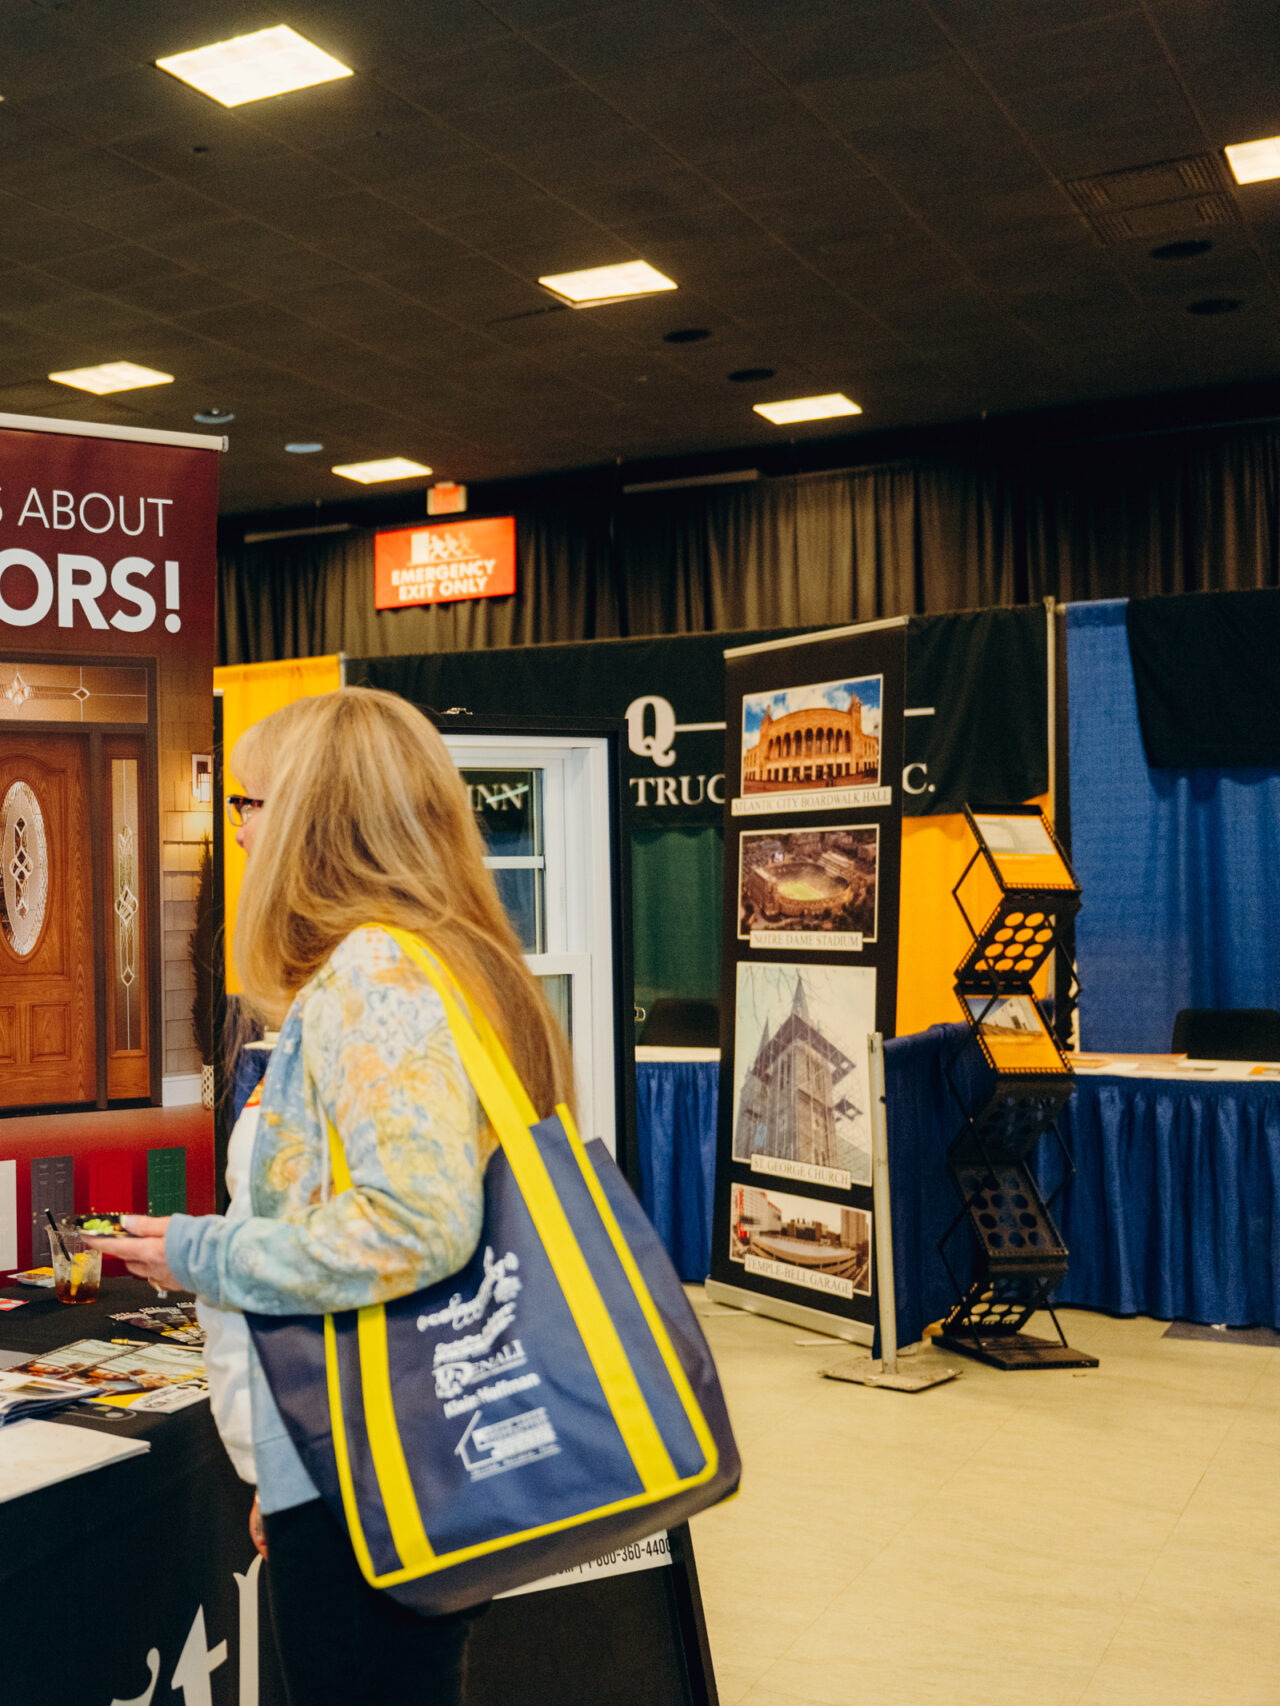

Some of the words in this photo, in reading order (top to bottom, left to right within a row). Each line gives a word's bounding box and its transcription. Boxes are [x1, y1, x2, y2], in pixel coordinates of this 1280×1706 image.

[18, 488, 173, 537] ABOUT
[391, 558, 496, 586] EMERGENCY
[398, 583, 435, 601] EXIT
[439, 576, 488, 596] ONLY
[629, 774, 726, 807] TRUC
[733, 799, 772, 813] ATLANTIC
[776, 797, 798, 810] CITY
[800, 791, 861, 808] BOARDWALK
[862, 789, 890, 802] HALL
[753, 933, 783, 944] NOTRE
[786, 933, 813, 945] DAME
[816, 934, 859, 947] STADIUM
[767, 1160, 805, 1177] GEORGE
[807, 1167, 849, 1186] CHURCH
[809, 1273, 850, 1295] GARAGE
